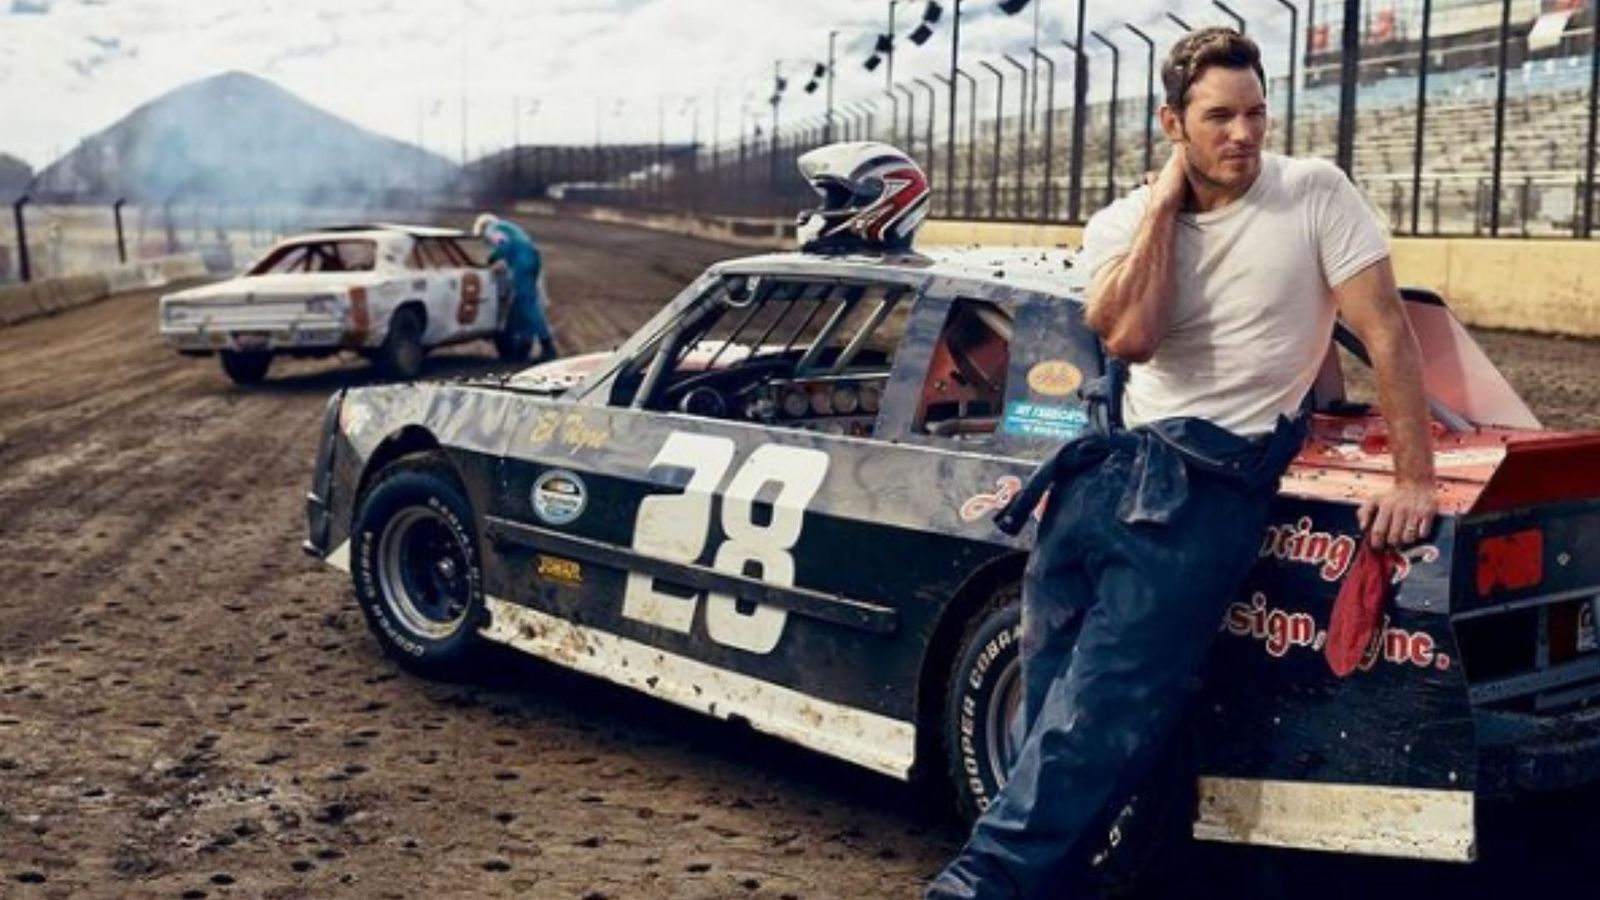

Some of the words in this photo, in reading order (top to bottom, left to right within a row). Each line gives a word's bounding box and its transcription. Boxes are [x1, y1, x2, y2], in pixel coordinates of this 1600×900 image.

[457, 272, 481, 325] 8
[621, 430, 830, 655] 28
[1221, 592, 1328, 657] sign,
